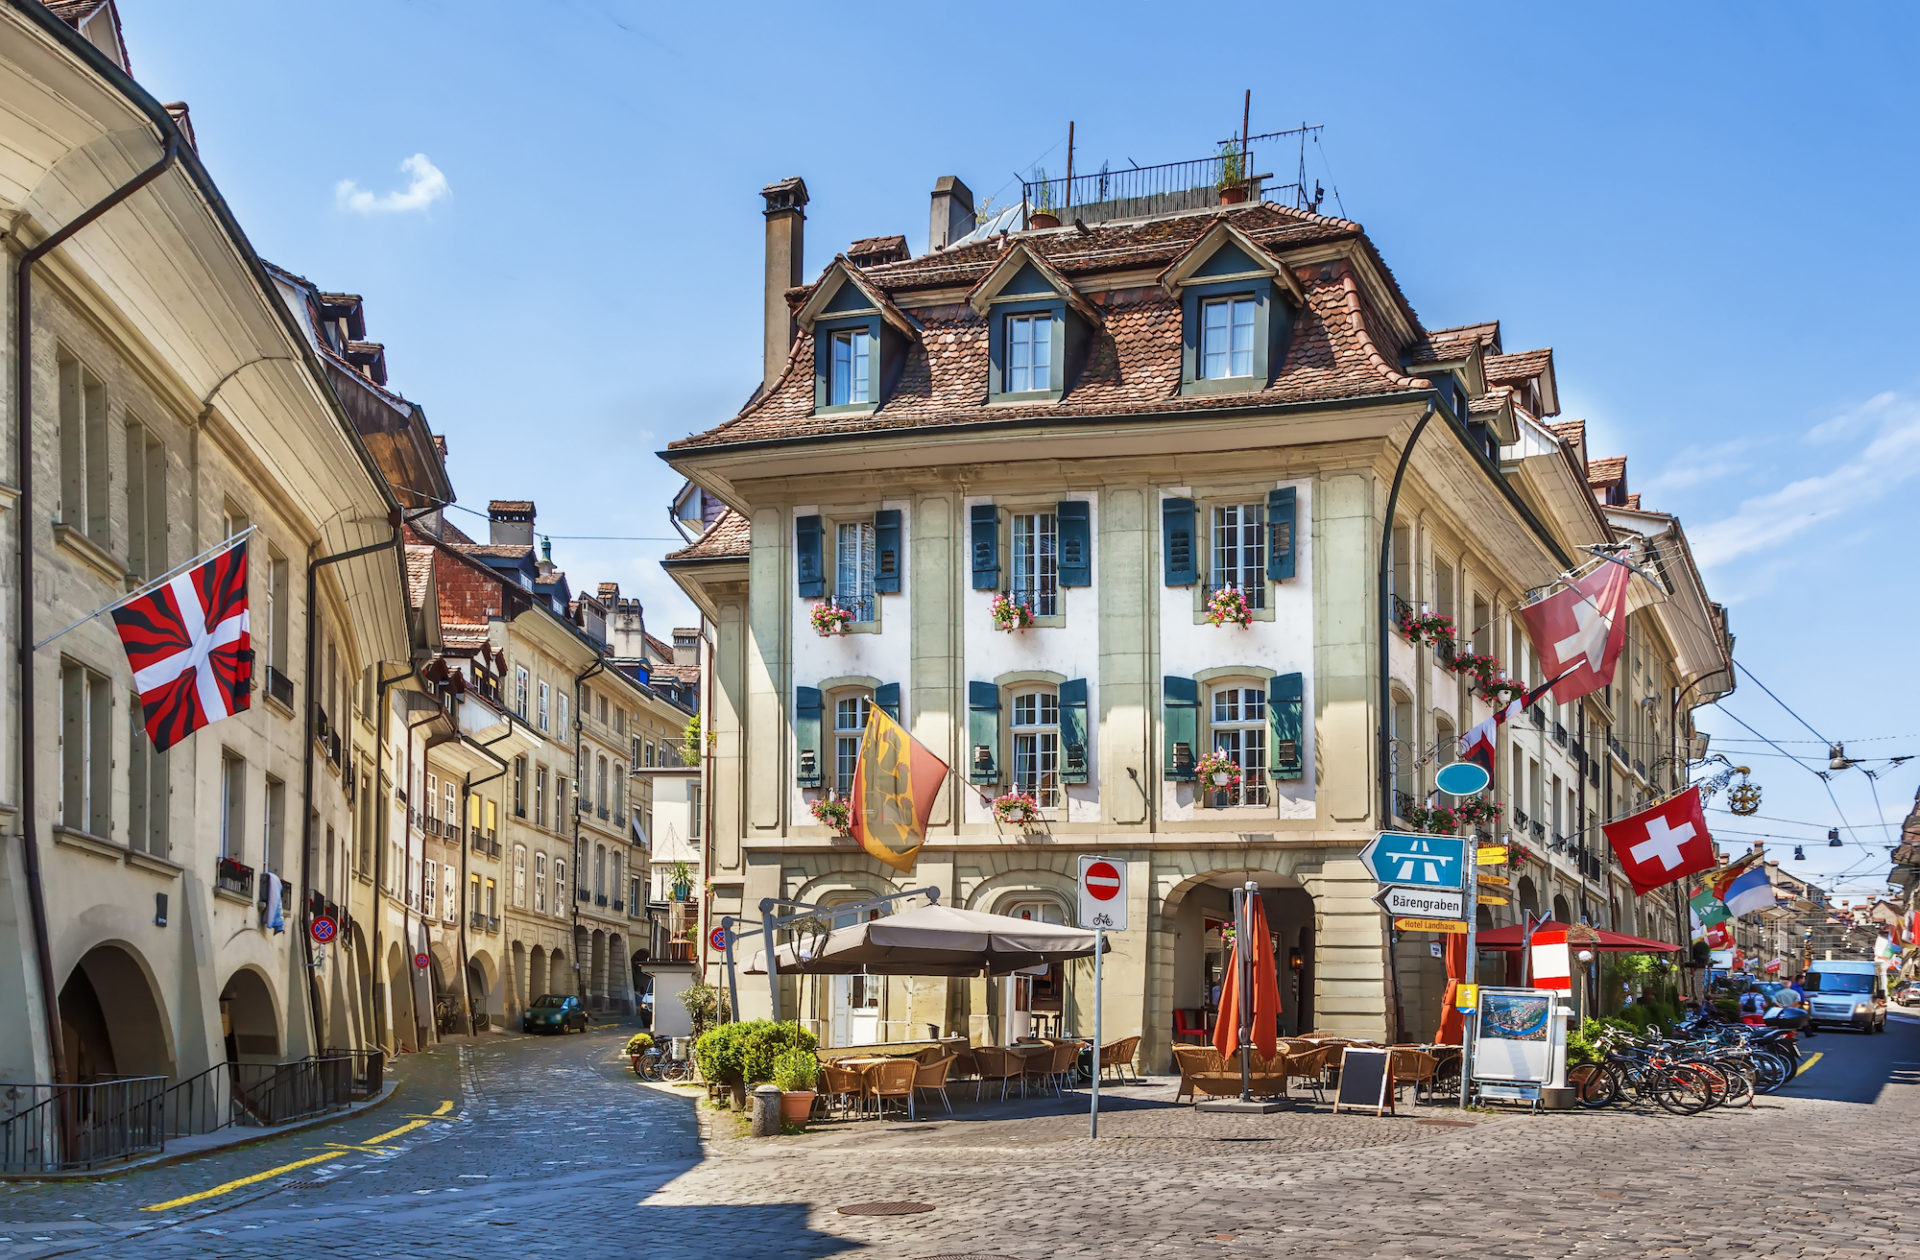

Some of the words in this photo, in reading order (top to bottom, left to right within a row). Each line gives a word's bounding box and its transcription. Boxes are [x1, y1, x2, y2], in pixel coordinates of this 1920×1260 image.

[1393, 895, 1459, 912] Bärengraben
[1405, 920, 1423, 929] Hotel
[1424, 921, 1456, 930] Landhaus
